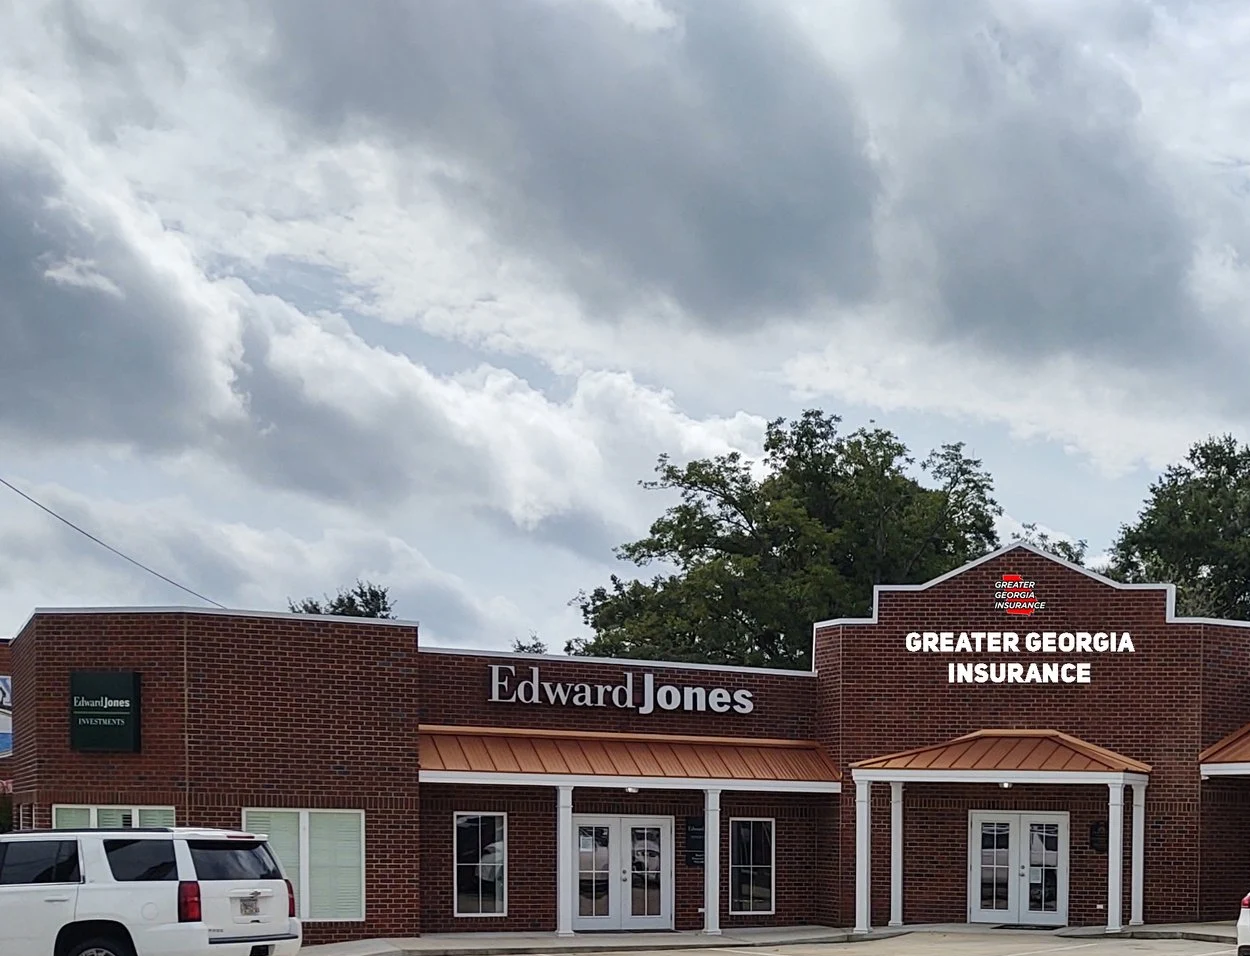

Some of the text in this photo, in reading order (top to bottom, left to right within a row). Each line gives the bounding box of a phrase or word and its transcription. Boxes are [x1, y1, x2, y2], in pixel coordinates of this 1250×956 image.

[994, 581, 1036, 589] GREATER
[994, 591, 1035, 599] GEORGIA
[994, 601, 1047, 609] INSURANCE
[905, 631, 1136, 653] GREATER GEORGIA
[948, 662, 1092, 684] INSURANCE
[78, 718, 126, 726] INVESTMENTS
